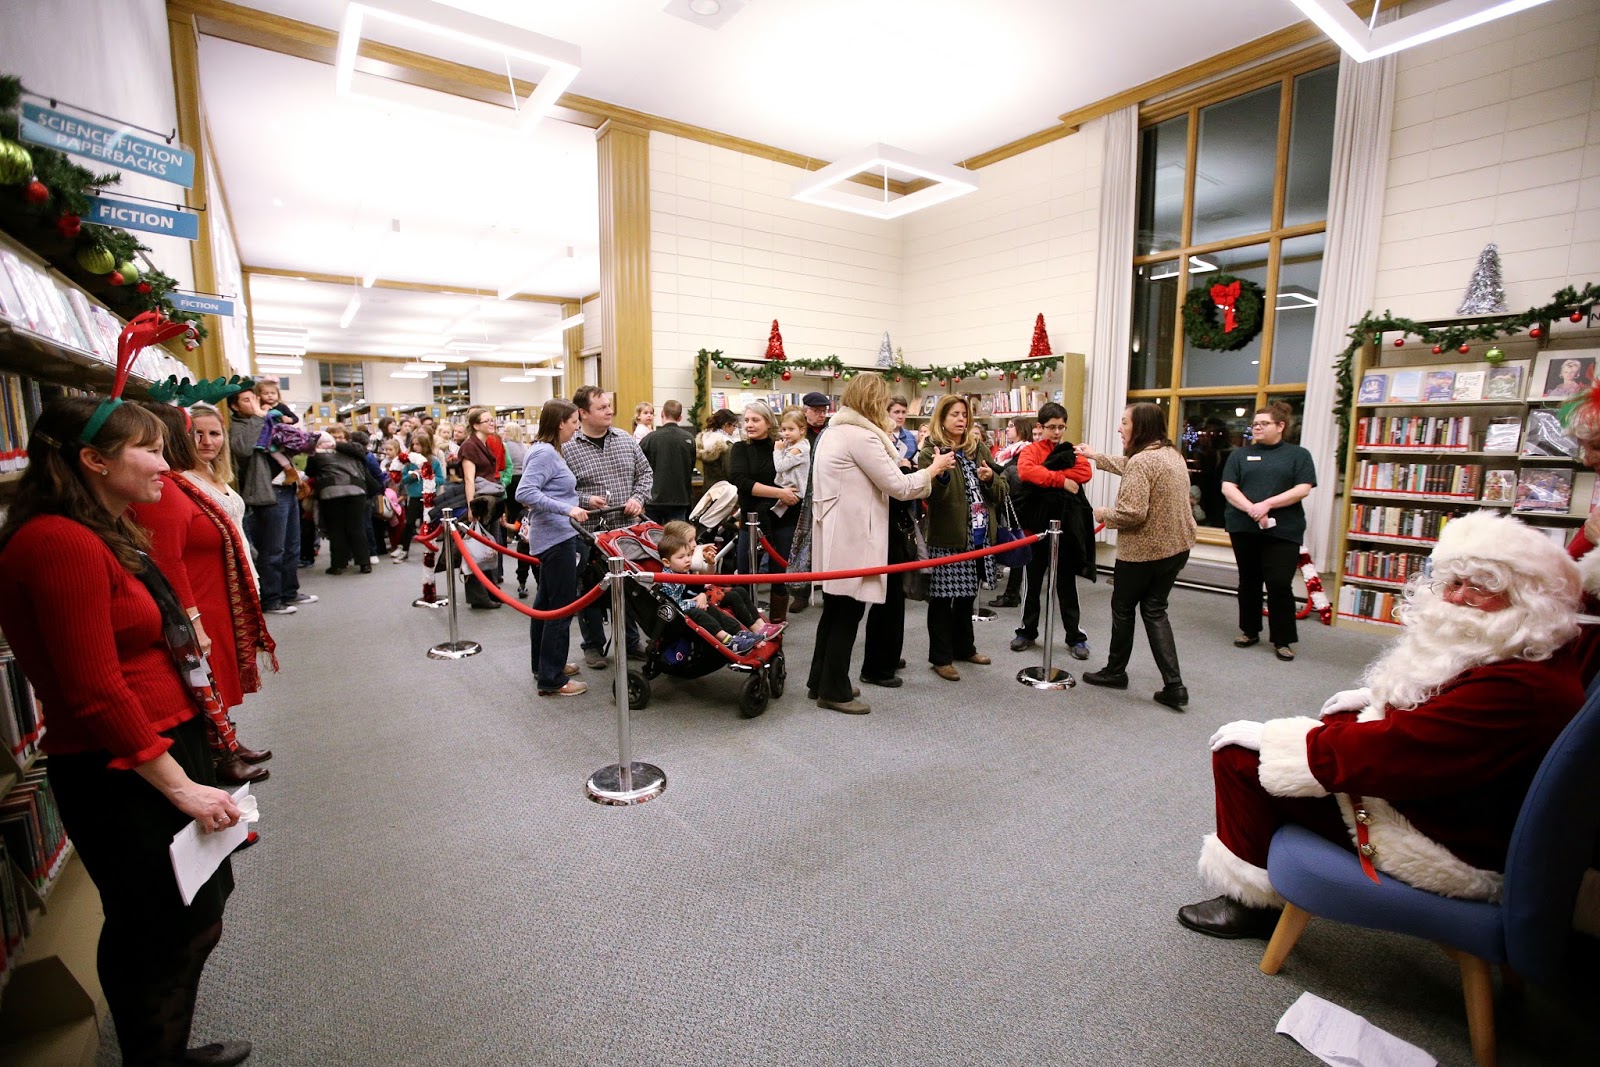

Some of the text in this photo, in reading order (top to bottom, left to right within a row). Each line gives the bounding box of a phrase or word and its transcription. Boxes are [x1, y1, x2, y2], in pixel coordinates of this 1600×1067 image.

[38, 112, 183, 167] SCIENCE FICTION
[56, 132, 167, 175] PAPERBACKS
[100, 204, 174, 229] FICTION
[180, 299, 219, 311] FICTION
